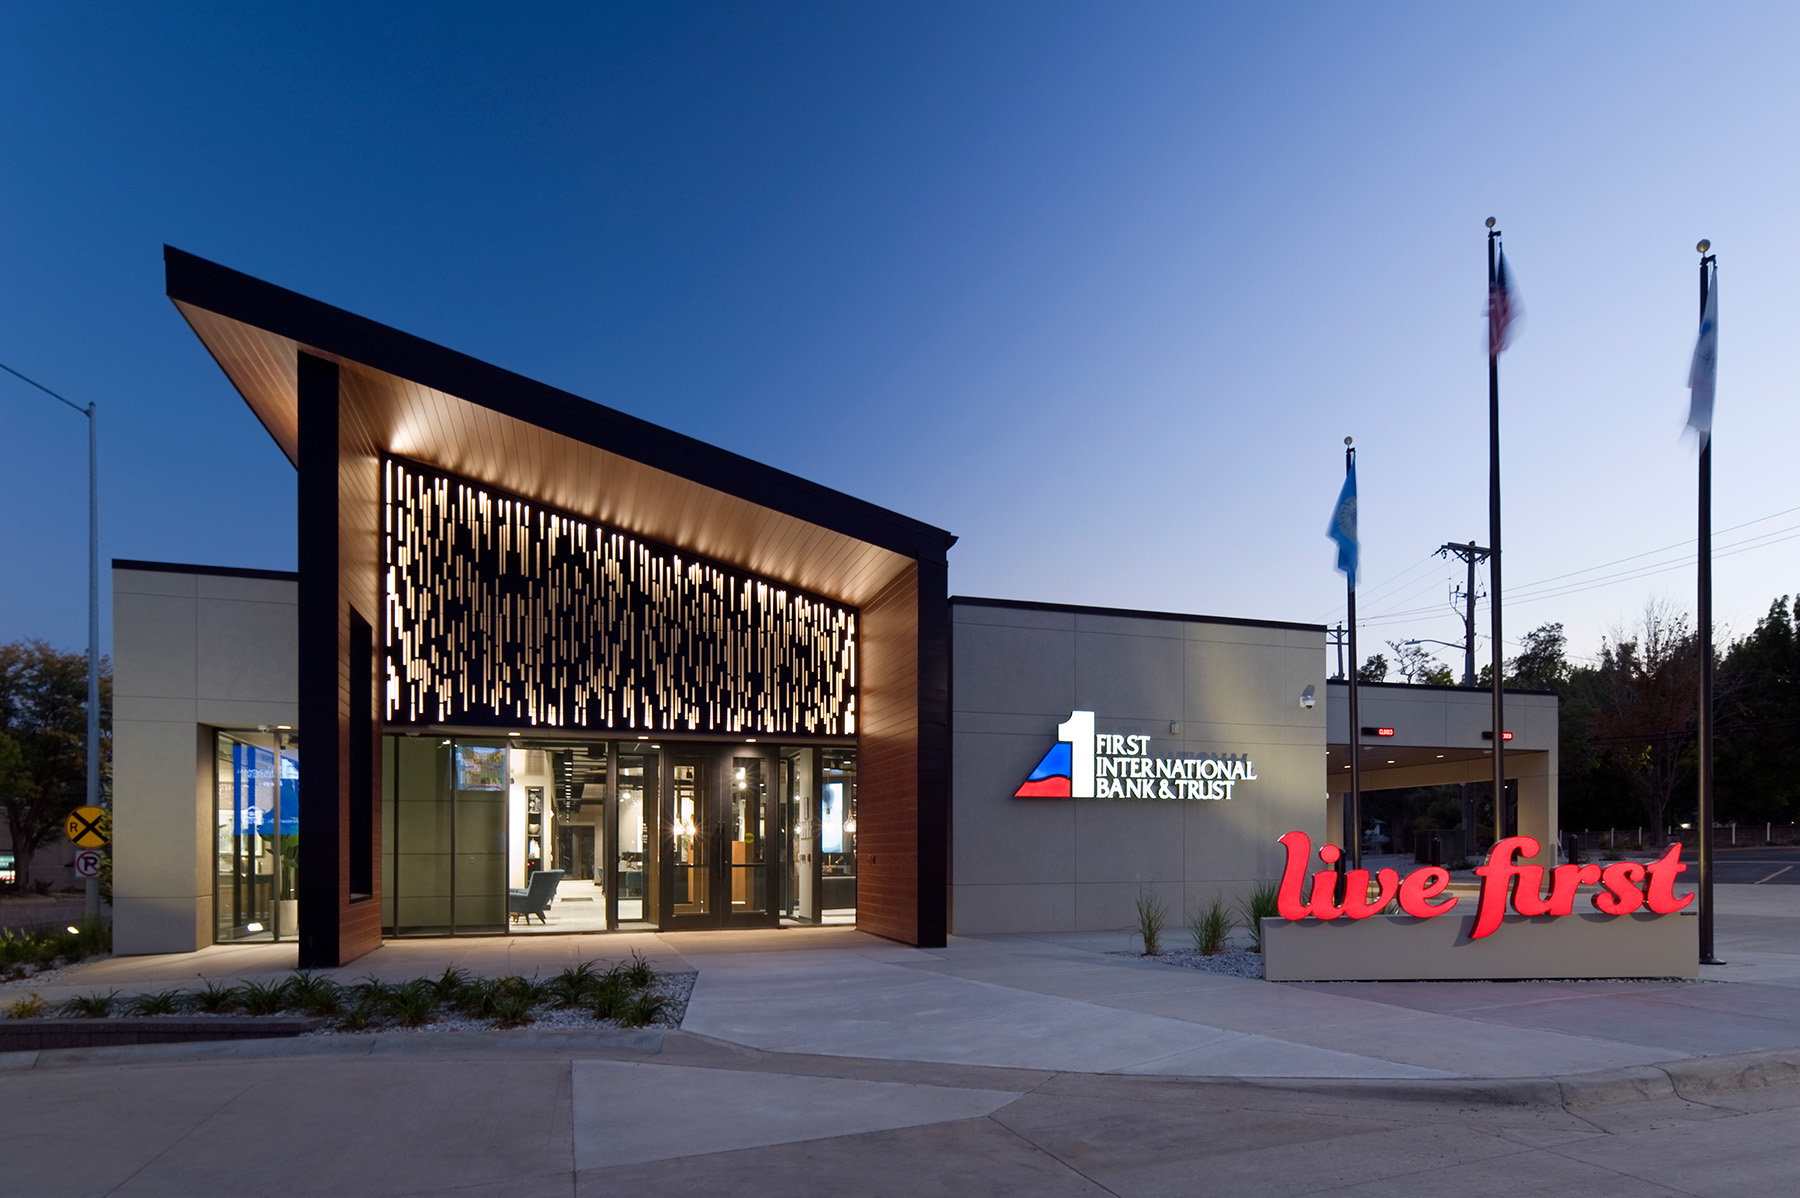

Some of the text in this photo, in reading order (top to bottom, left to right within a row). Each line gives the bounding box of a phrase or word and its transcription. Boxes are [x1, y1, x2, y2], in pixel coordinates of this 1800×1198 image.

[1058, 710, 1095, 798] 1
[1096, 734, 1151, 756] FIRST
[1096, 756, 1258, 780] INTERNATIONAL
[1096, 778, 1236, 800] BANK & TRUST
[69, 822, 78, 833] R
[1277, 831, 1695, 940] live first
